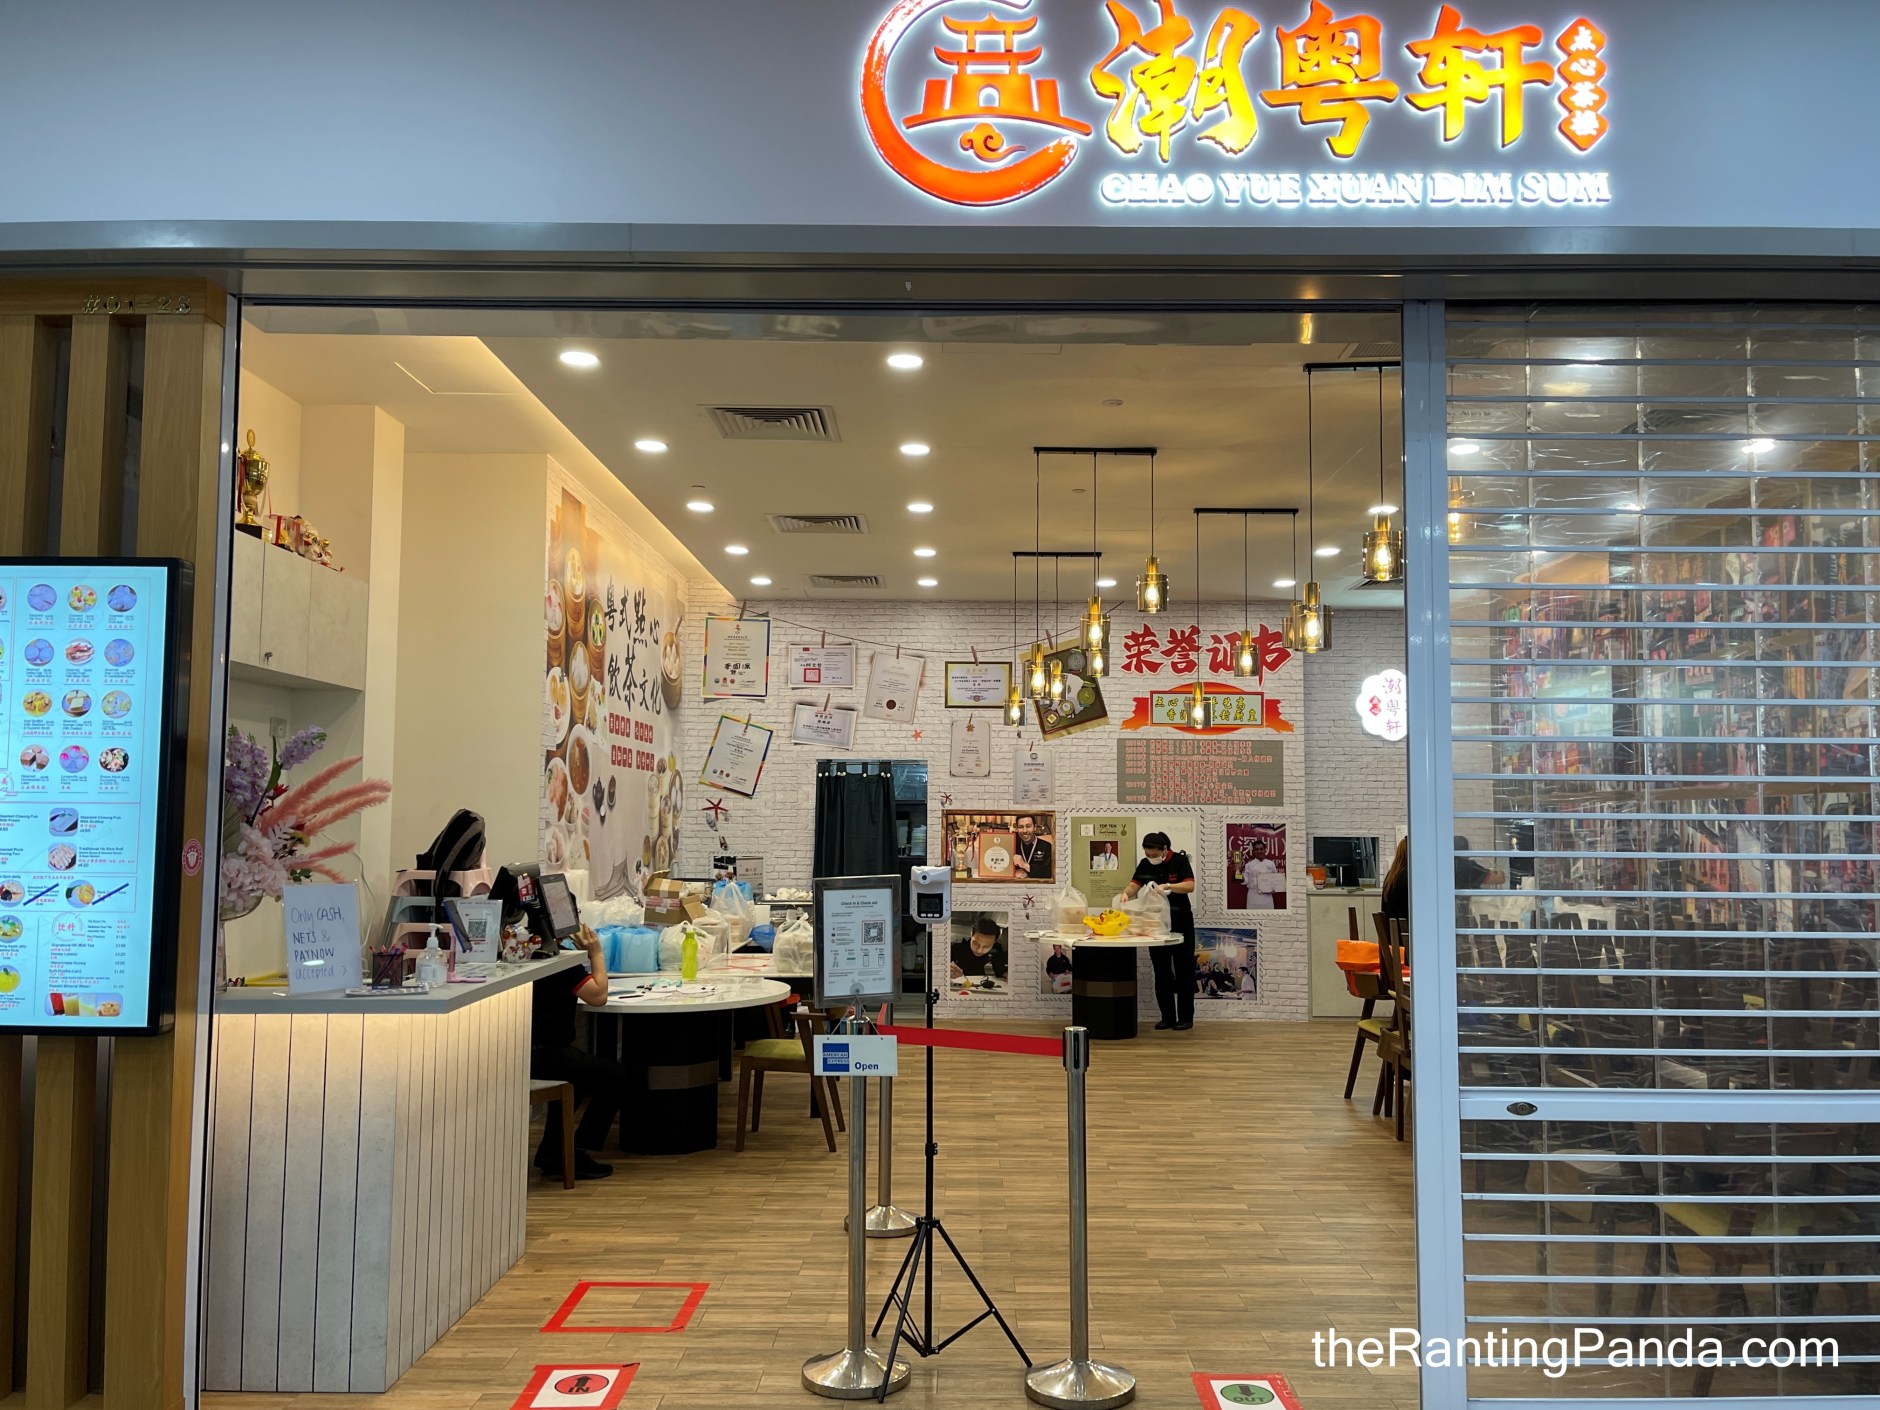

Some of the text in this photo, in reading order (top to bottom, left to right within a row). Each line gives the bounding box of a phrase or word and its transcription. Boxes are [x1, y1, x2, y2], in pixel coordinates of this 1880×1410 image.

[1090, 0, 1556, 163] 潮粤轩
[1100, 173, 1612, 206] CHAO YUE XUAN DIM SUM
[1120, 623, 1292, 687] 荣誉证书
[607, 643, 661, 715] 飲茶文化
[291, 907, 314, 930] Only
[293, 929, 331, 944] NETS &
[295, 947, 335, 962] PAYNOW
[295, 965, 334, 979] accepted
[854, 1062, 879, 1071] Open
